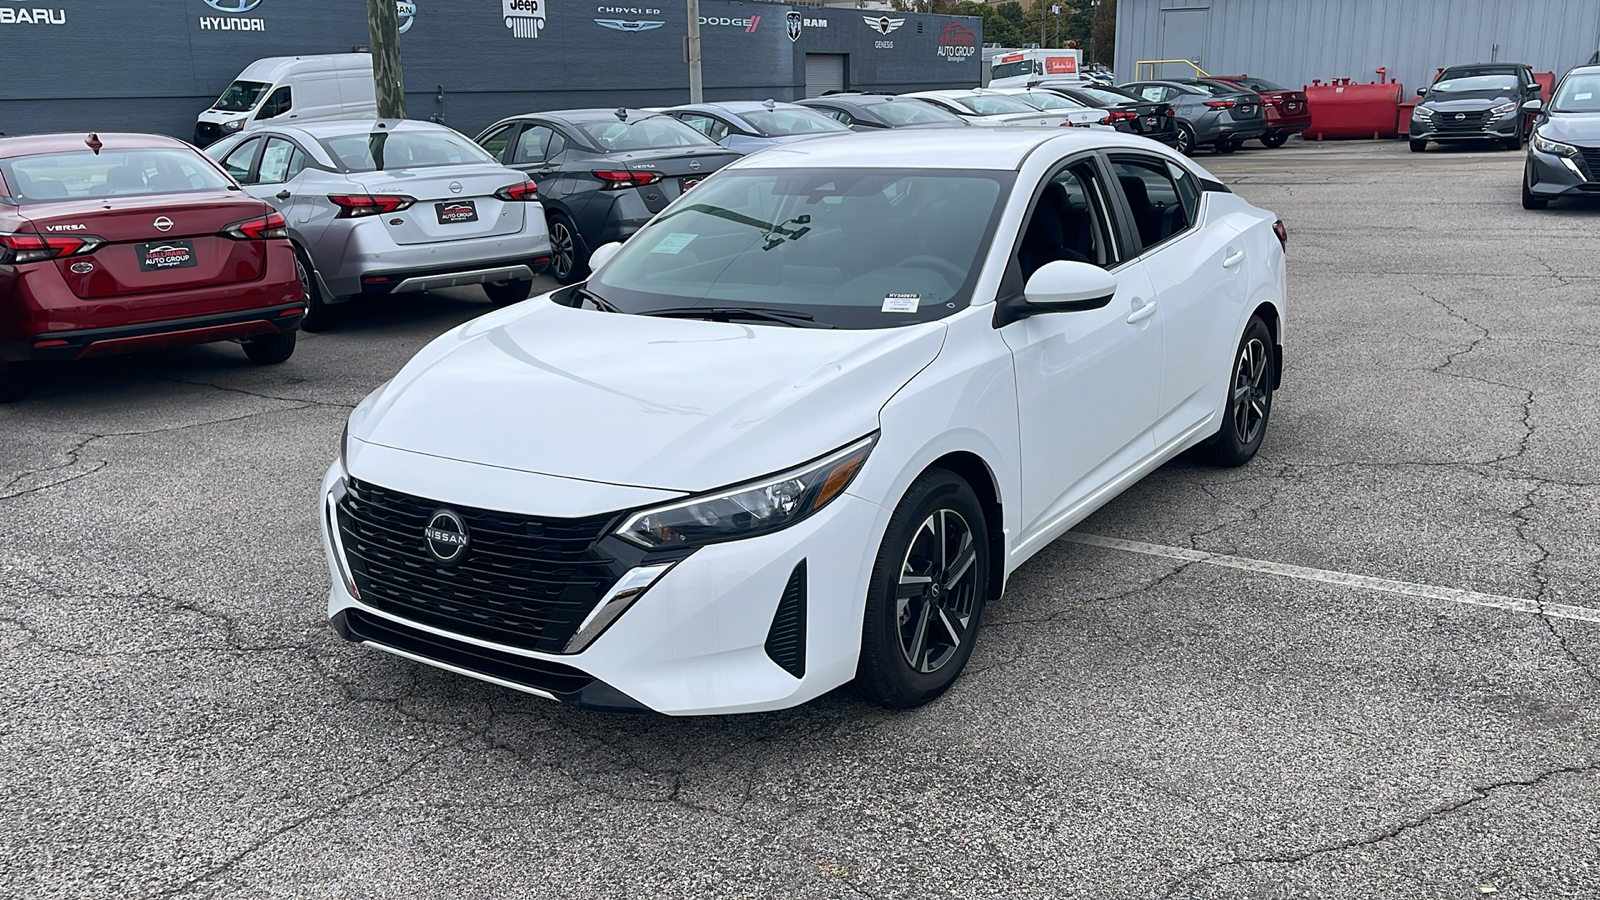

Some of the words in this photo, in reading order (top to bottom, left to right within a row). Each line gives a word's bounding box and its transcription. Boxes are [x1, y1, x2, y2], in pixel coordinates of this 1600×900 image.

[510, 0, 538, 14] Jeep
[597, 6, 660, 15] CHRYSLER
[200, 17, 265, 31] HYUNDAI
[699, 16, 753, 27] DODGE
[803, 18, 828, 28] RAM
[874, 40, 894, 49] GENESIS
[937, 45, 954, 57] AUTO
[955, 46, 975, 57] GROUP
[46, 224, 87, 232] VERSA
[145, 257, 165, 265] AUTO
[166, 254, 190, 263] GROUP
[146, 251, 187, 259] HALLMARK
[425, 528, 467, 545] NISSAN
